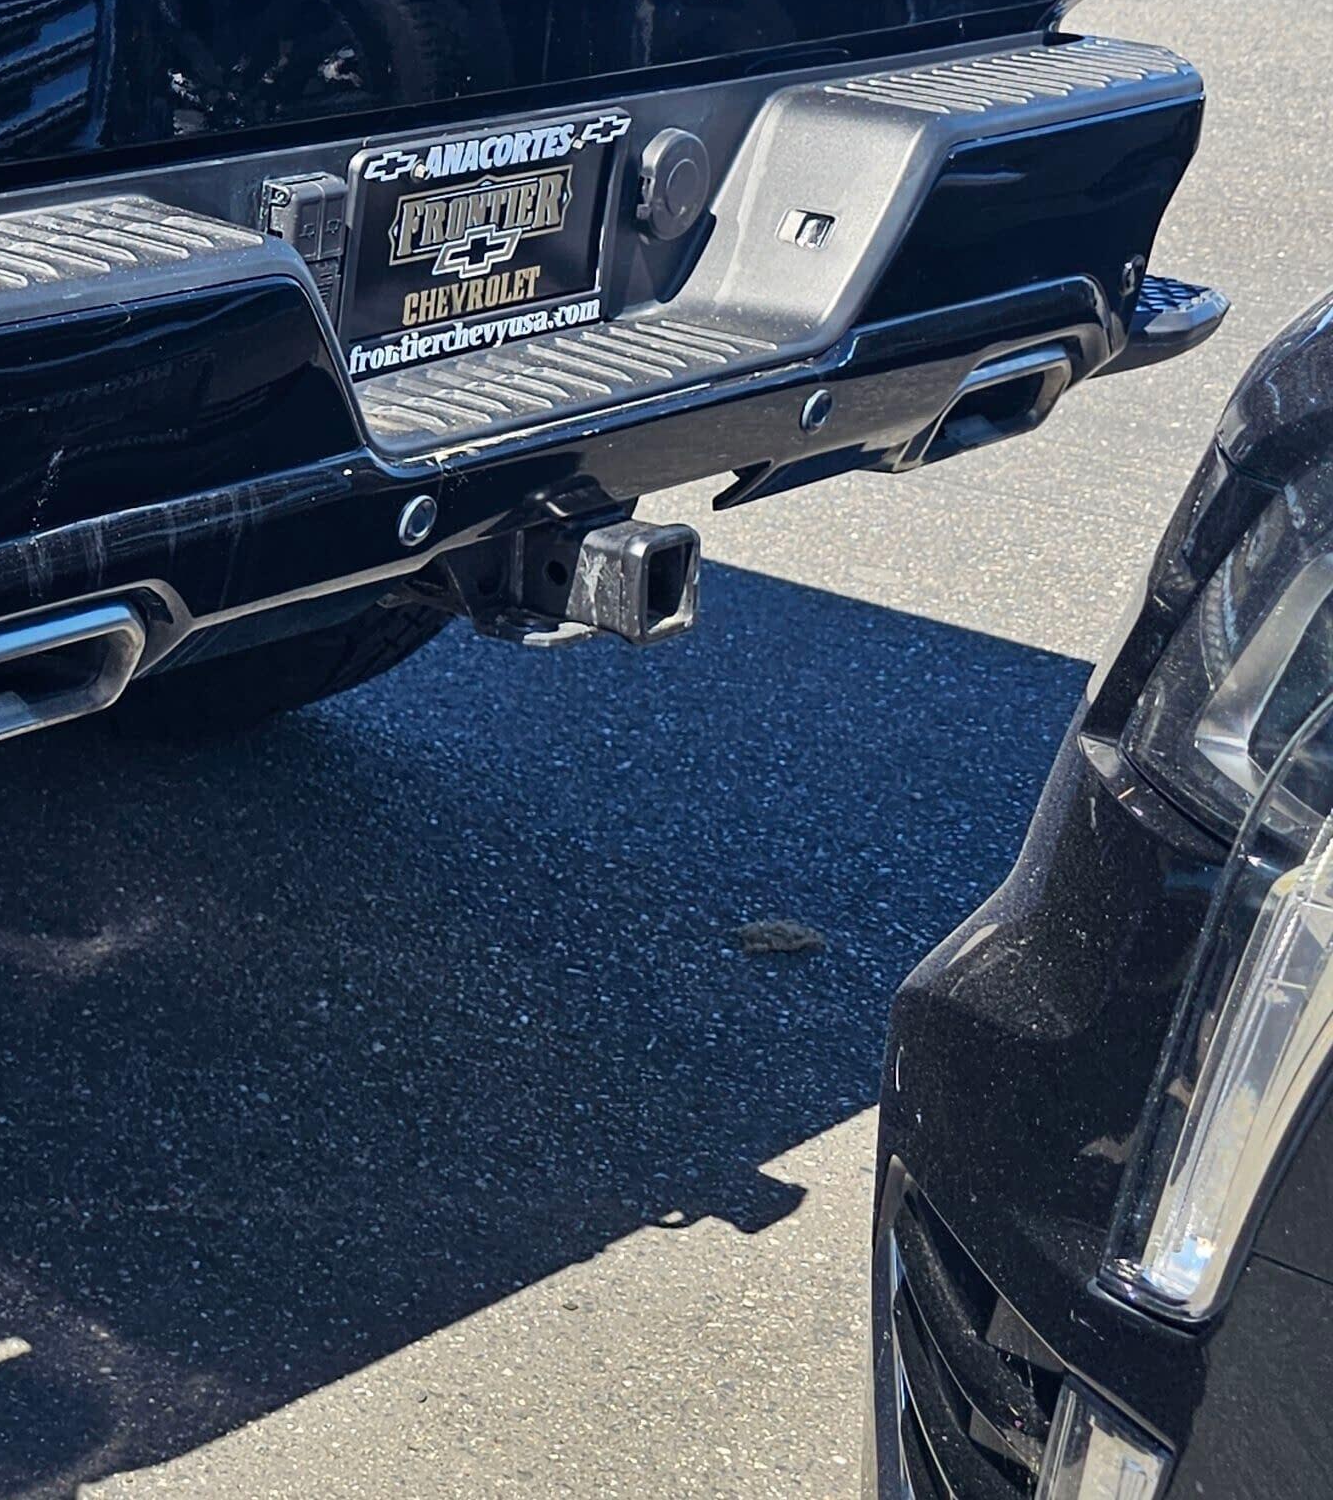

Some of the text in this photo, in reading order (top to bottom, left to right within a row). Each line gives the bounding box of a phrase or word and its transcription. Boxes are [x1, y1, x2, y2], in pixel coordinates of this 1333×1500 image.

[421, 123, 576, 180] ANACORTES
[396, 173, 565, 257] FRONTIER
[400, 265, 542, 327] CHEVROLET
[347, 298, 602, 375] frontierchevyusa.com
